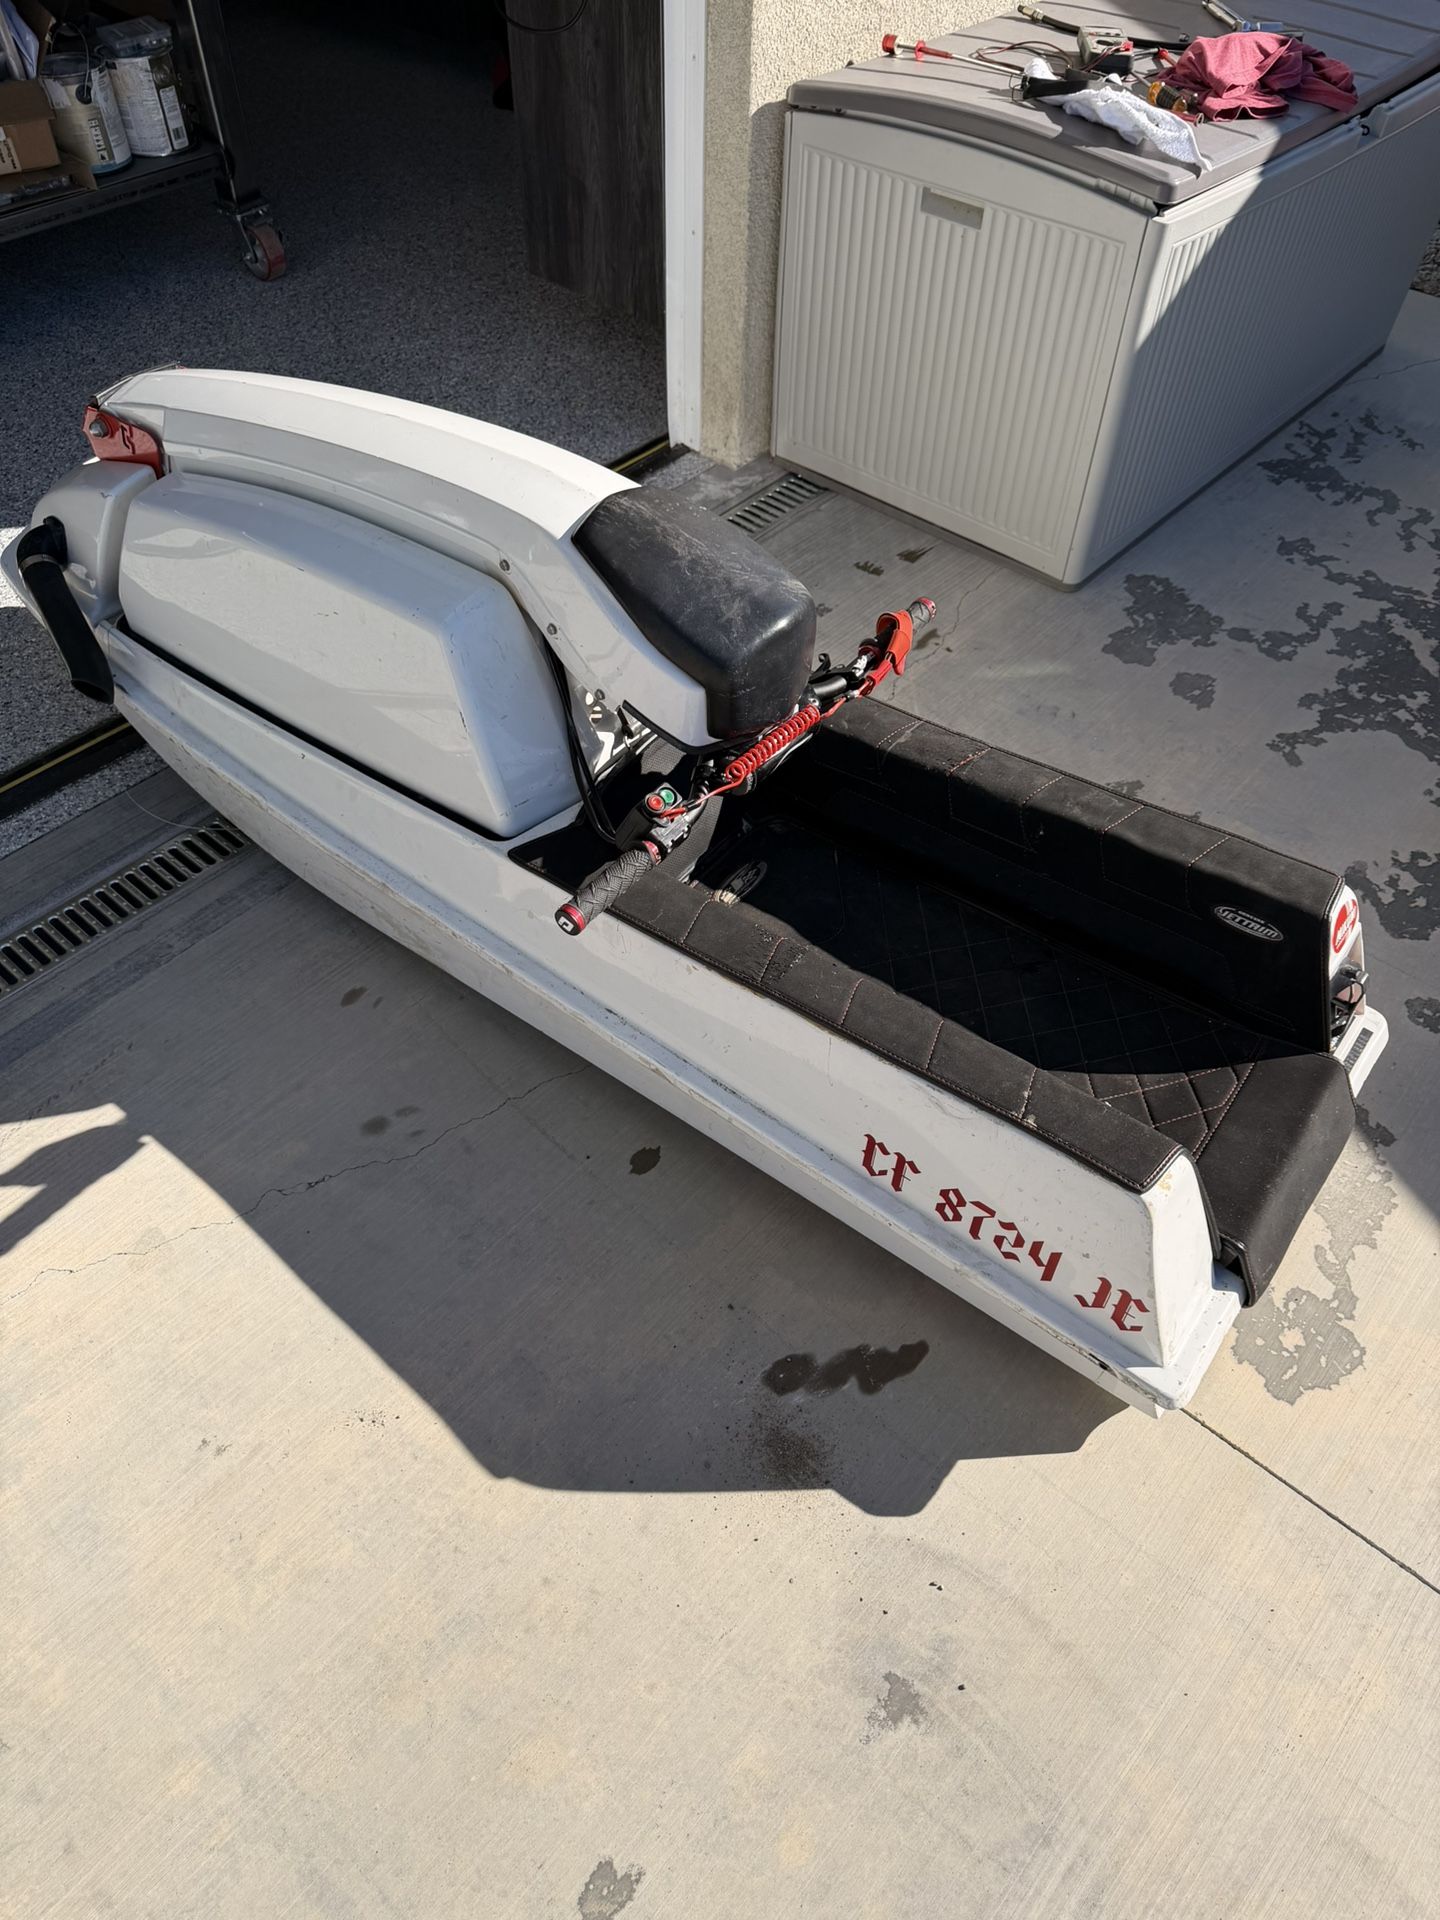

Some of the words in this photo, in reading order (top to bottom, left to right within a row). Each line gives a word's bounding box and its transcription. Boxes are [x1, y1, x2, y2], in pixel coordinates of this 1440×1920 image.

[1219, 907, 1279, 938] JETTRIM
[935, 1188, 1063, 1281] 8724
[1074, 1277, 1150, 1332] JE
